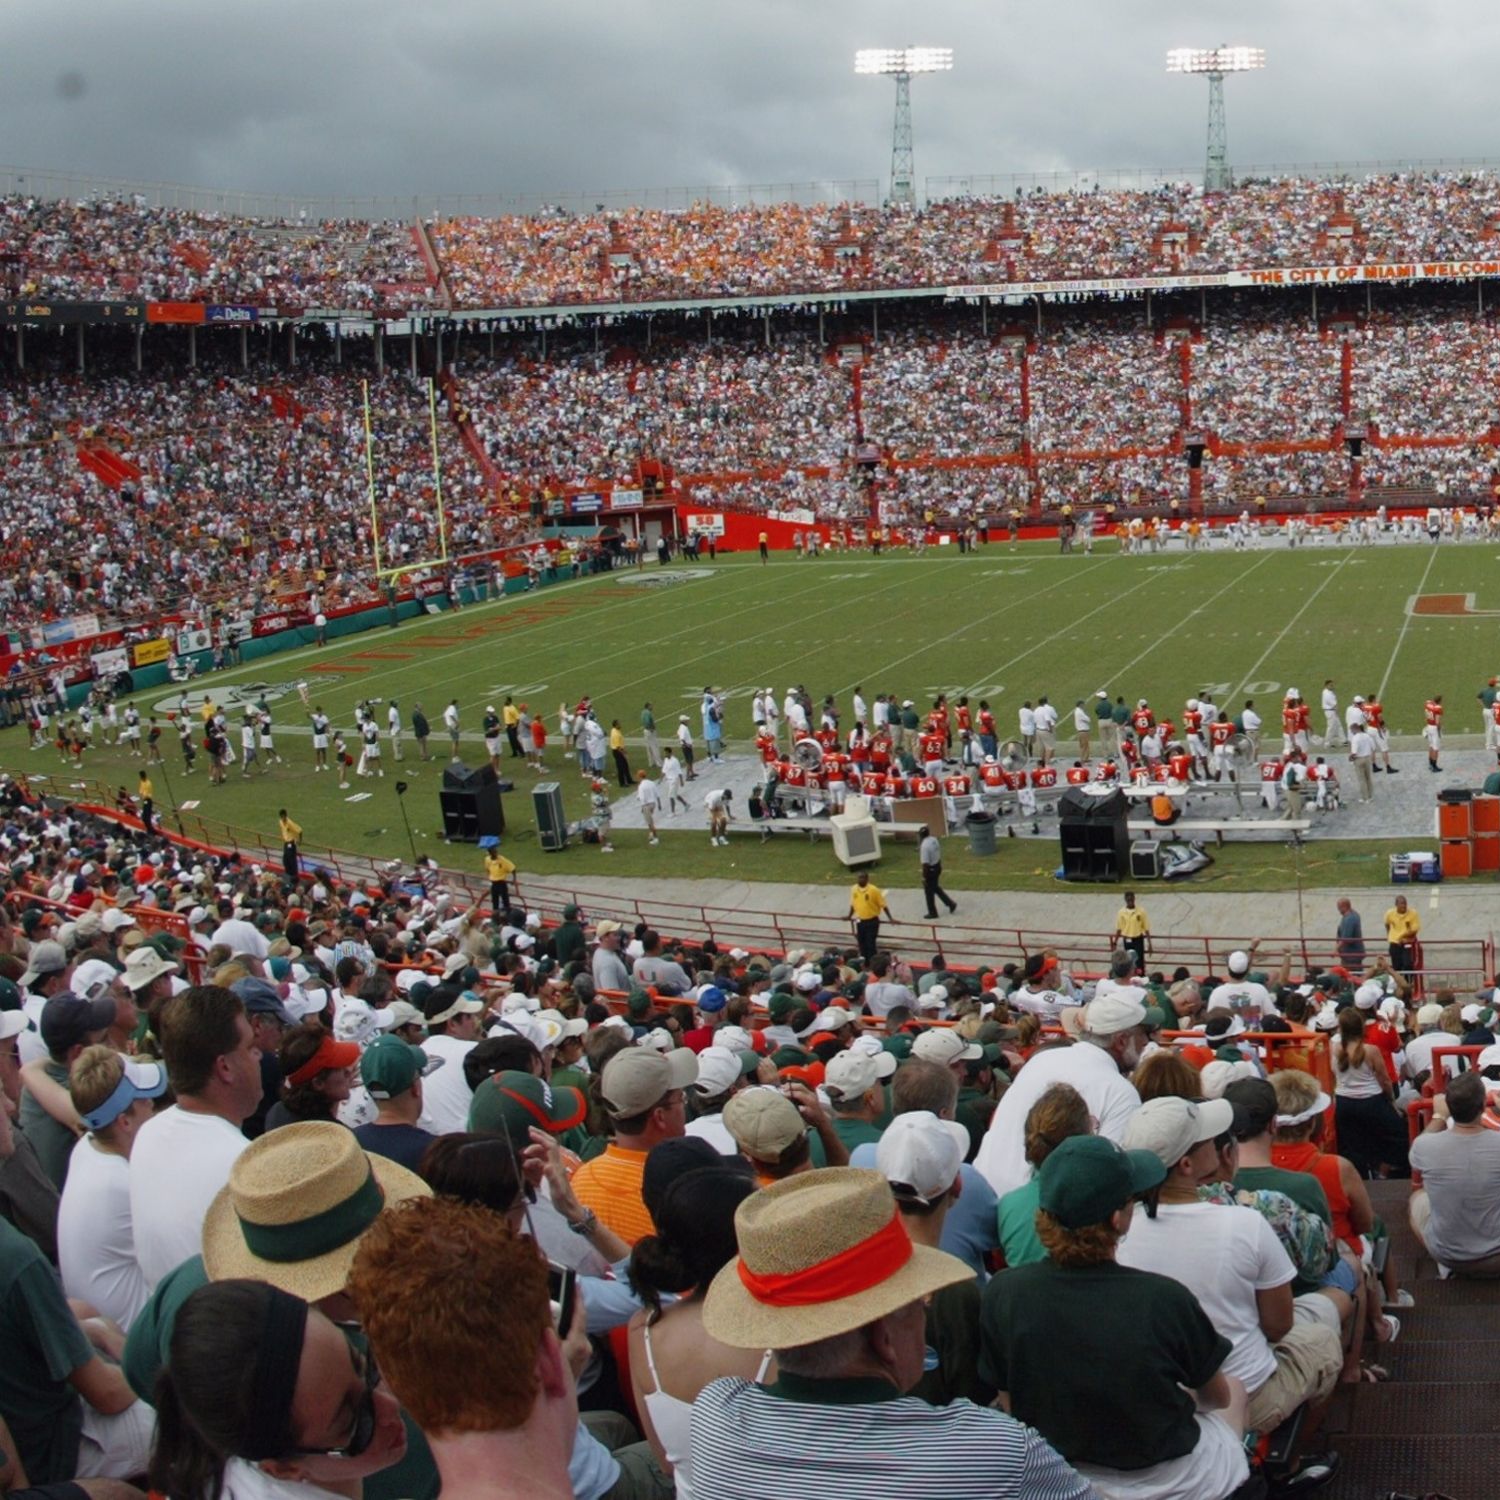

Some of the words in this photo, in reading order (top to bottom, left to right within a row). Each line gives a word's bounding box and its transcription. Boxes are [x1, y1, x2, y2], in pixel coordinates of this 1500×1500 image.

[1289, 268, 1330, 282] CITY
[1336, 267, 1358, 280] OF
[1364, 264, 1416, 279] MIAMI
[225, 308, 250, 321] Delta
[1214, 728, 1228, 740] 47
[926, 740, 941, 753] 63
[787, 767, 801, 779] 67
[1073, 770, 1081, 780] 4
[863, 777, 877, 789] 76
[918, 780, 935, 792] 60
[950, 780, 965, 792] 34
